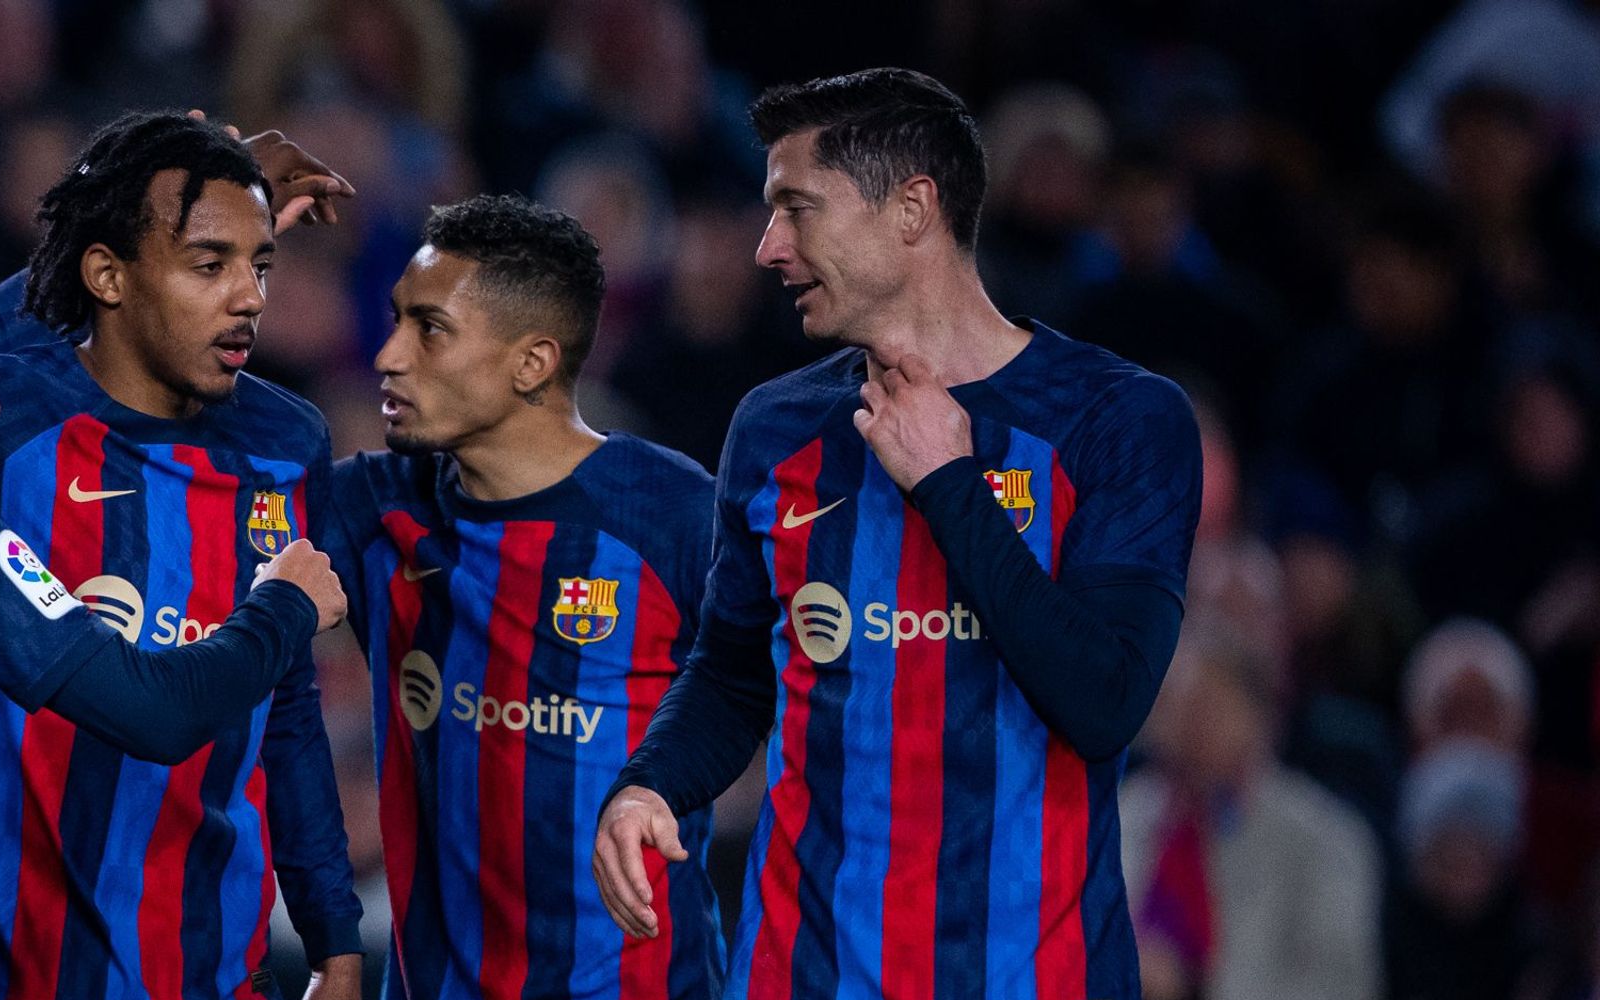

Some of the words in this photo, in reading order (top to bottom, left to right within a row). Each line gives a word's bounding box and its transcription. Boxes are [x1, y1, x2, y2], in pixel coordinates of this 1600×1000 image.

[573, 605, 599, 614] FCB
[863, 601, 989, 649] Spoti
[451, 682, 604, 744] Spotify
